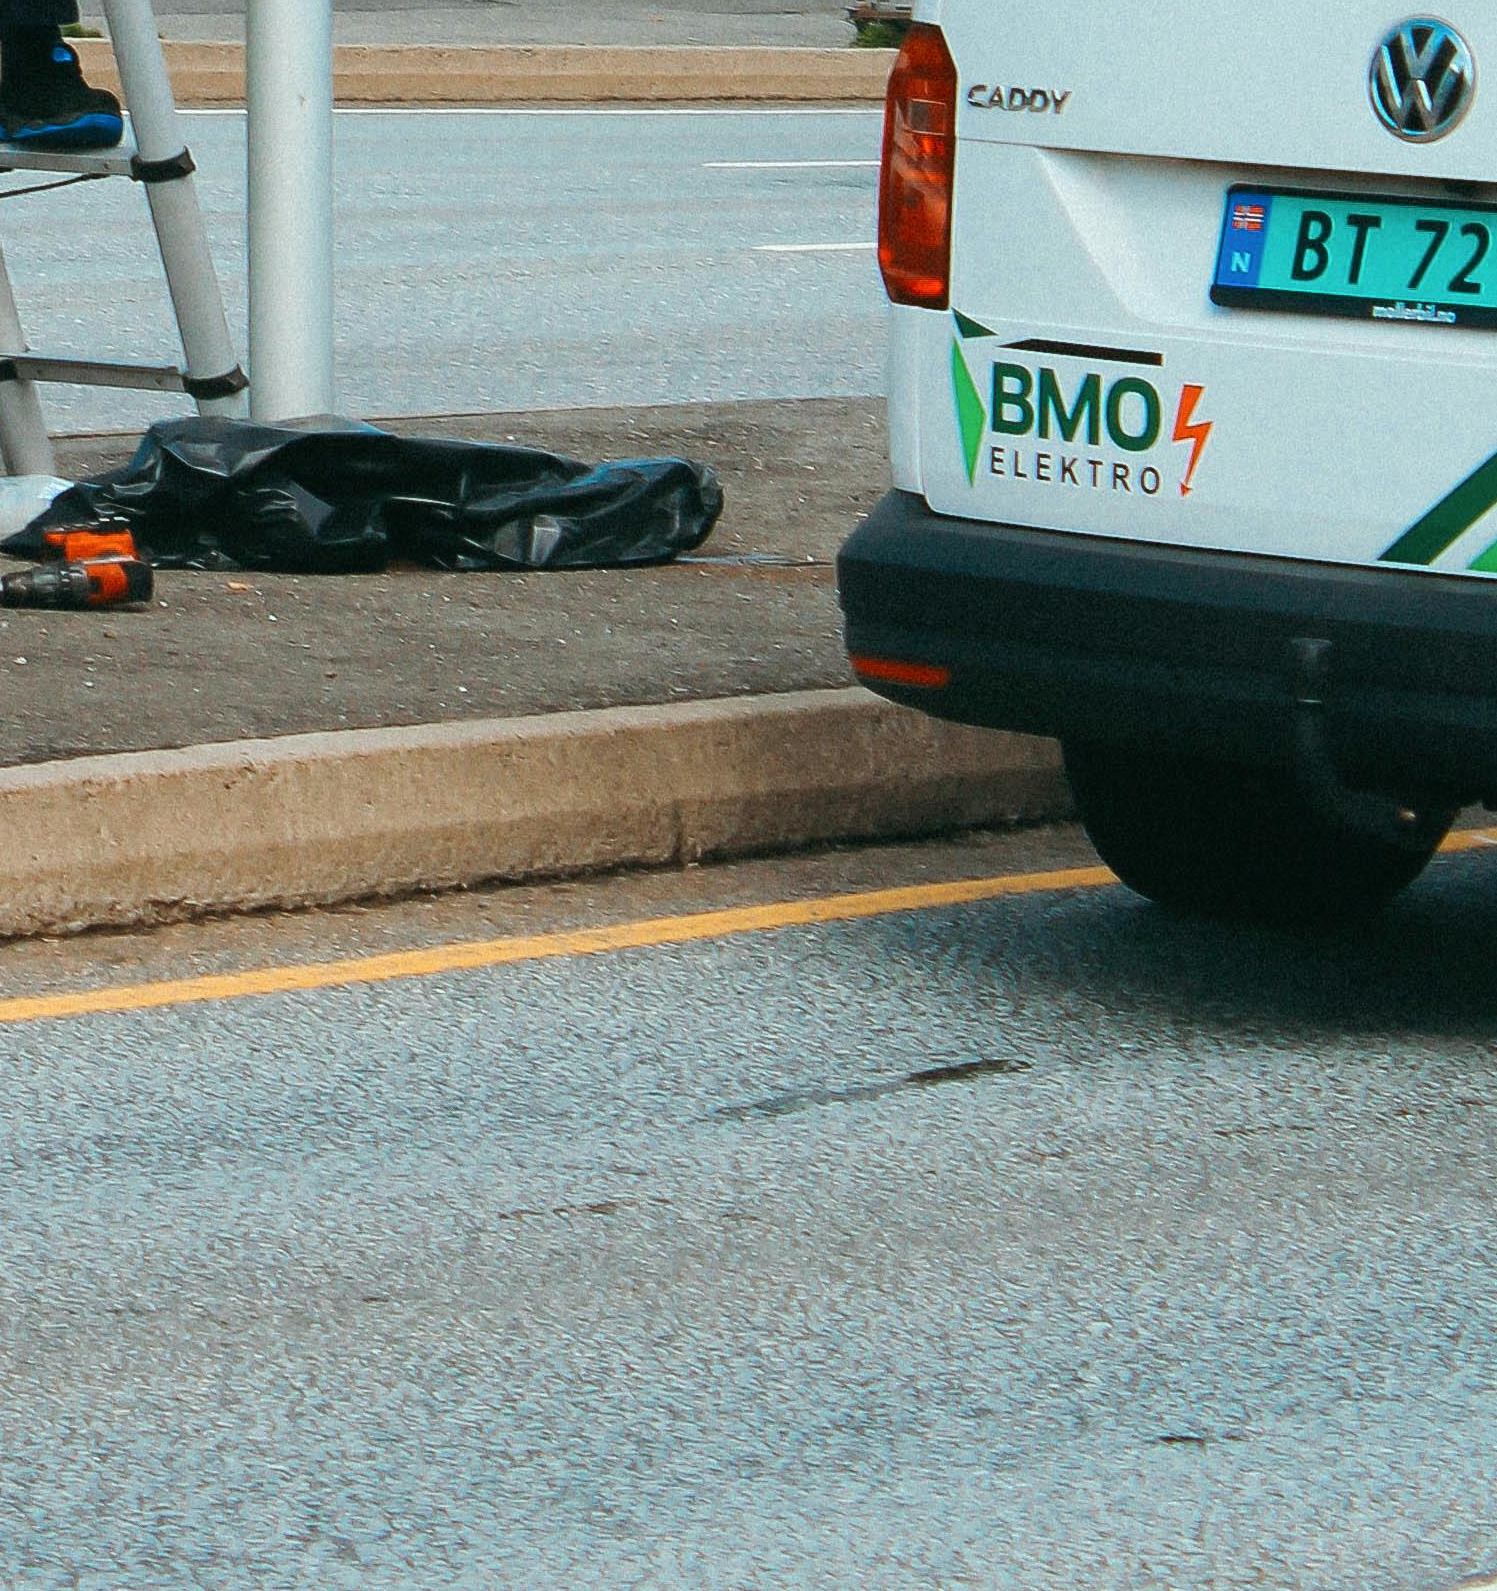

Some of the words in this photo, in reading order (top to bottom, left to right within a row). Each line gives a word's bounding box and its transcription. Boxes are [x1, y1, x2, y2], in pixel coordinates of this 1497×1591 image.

[967, 84, 1072, 114] CADDY
[1231, 251, 1251, 273] N
[1291, 209, 1382, 286] BT
[1407, 218, 1491, 295] 72
[991, 360, 1161, 452] BMO
[990, 445, 1161, 495] ELEKTRO
